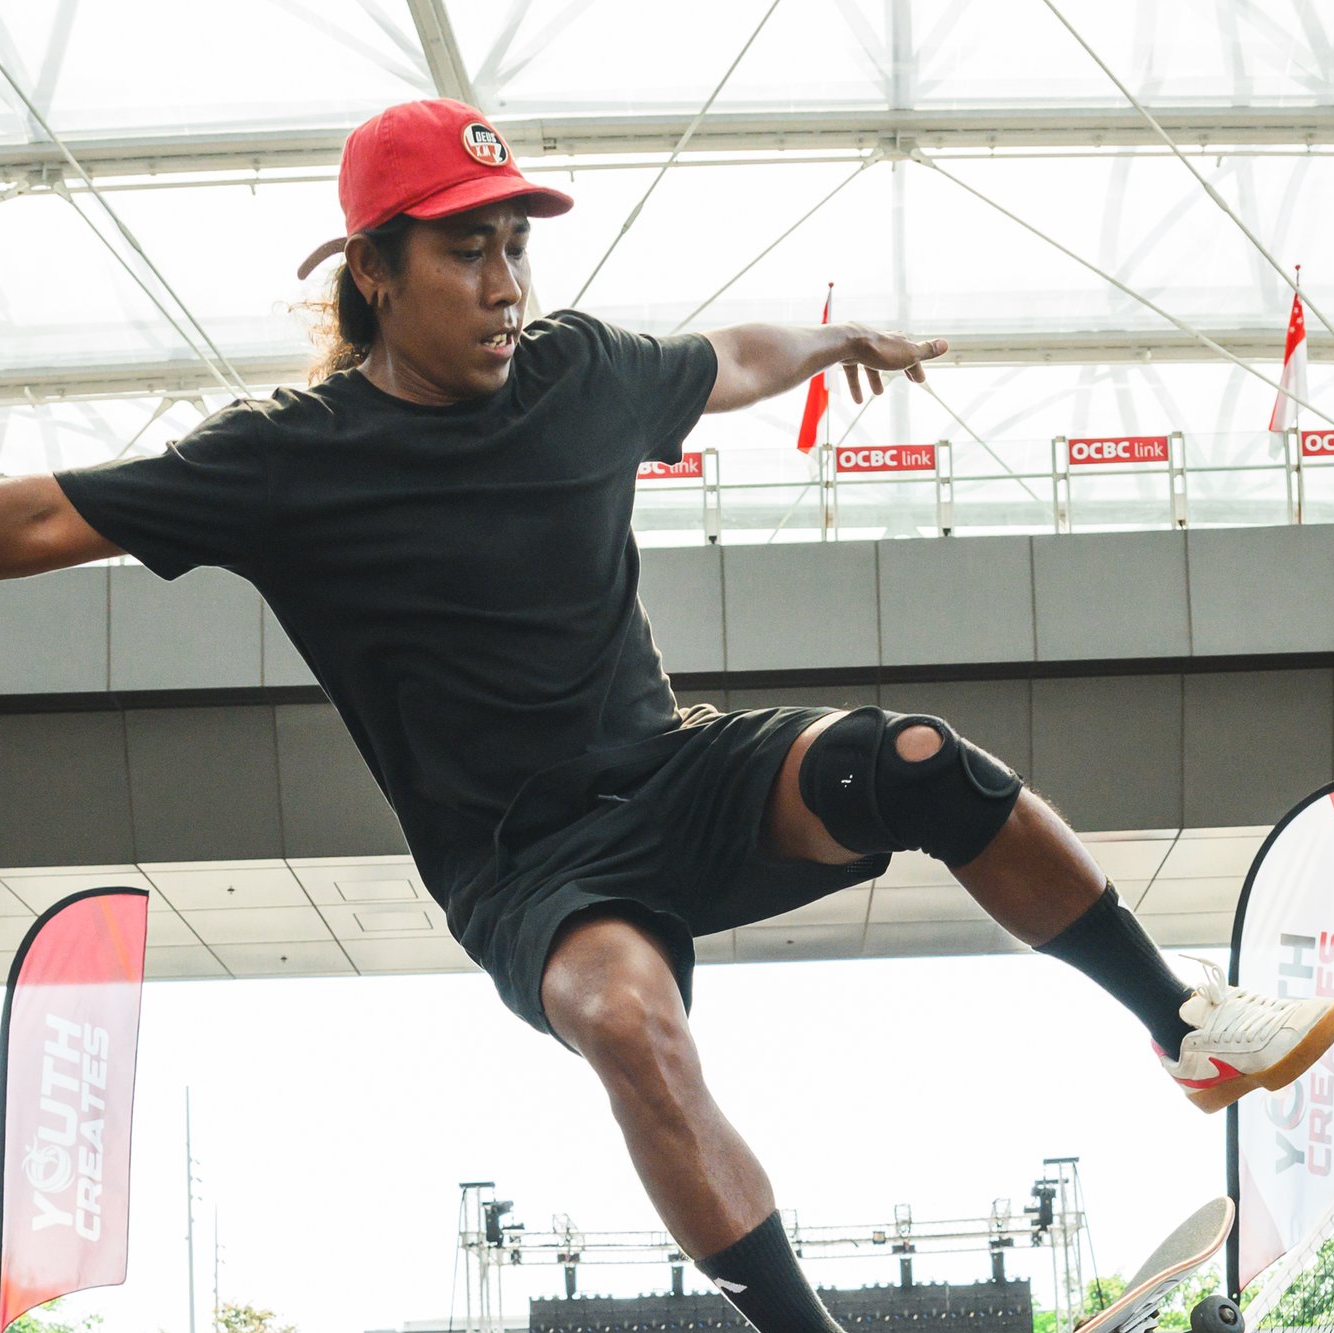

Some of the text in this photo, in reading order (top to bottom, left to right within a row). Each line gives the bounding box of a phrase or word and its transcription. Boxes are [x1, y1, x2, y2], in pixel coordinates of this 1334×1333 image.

[839, 449, 932, 468] OCBC link
[1071, 440, 1164, 460] OCBC link
[21, 1013, 83, 1232] YOUTH
[74, 1022, 110, 1243] CREATES
